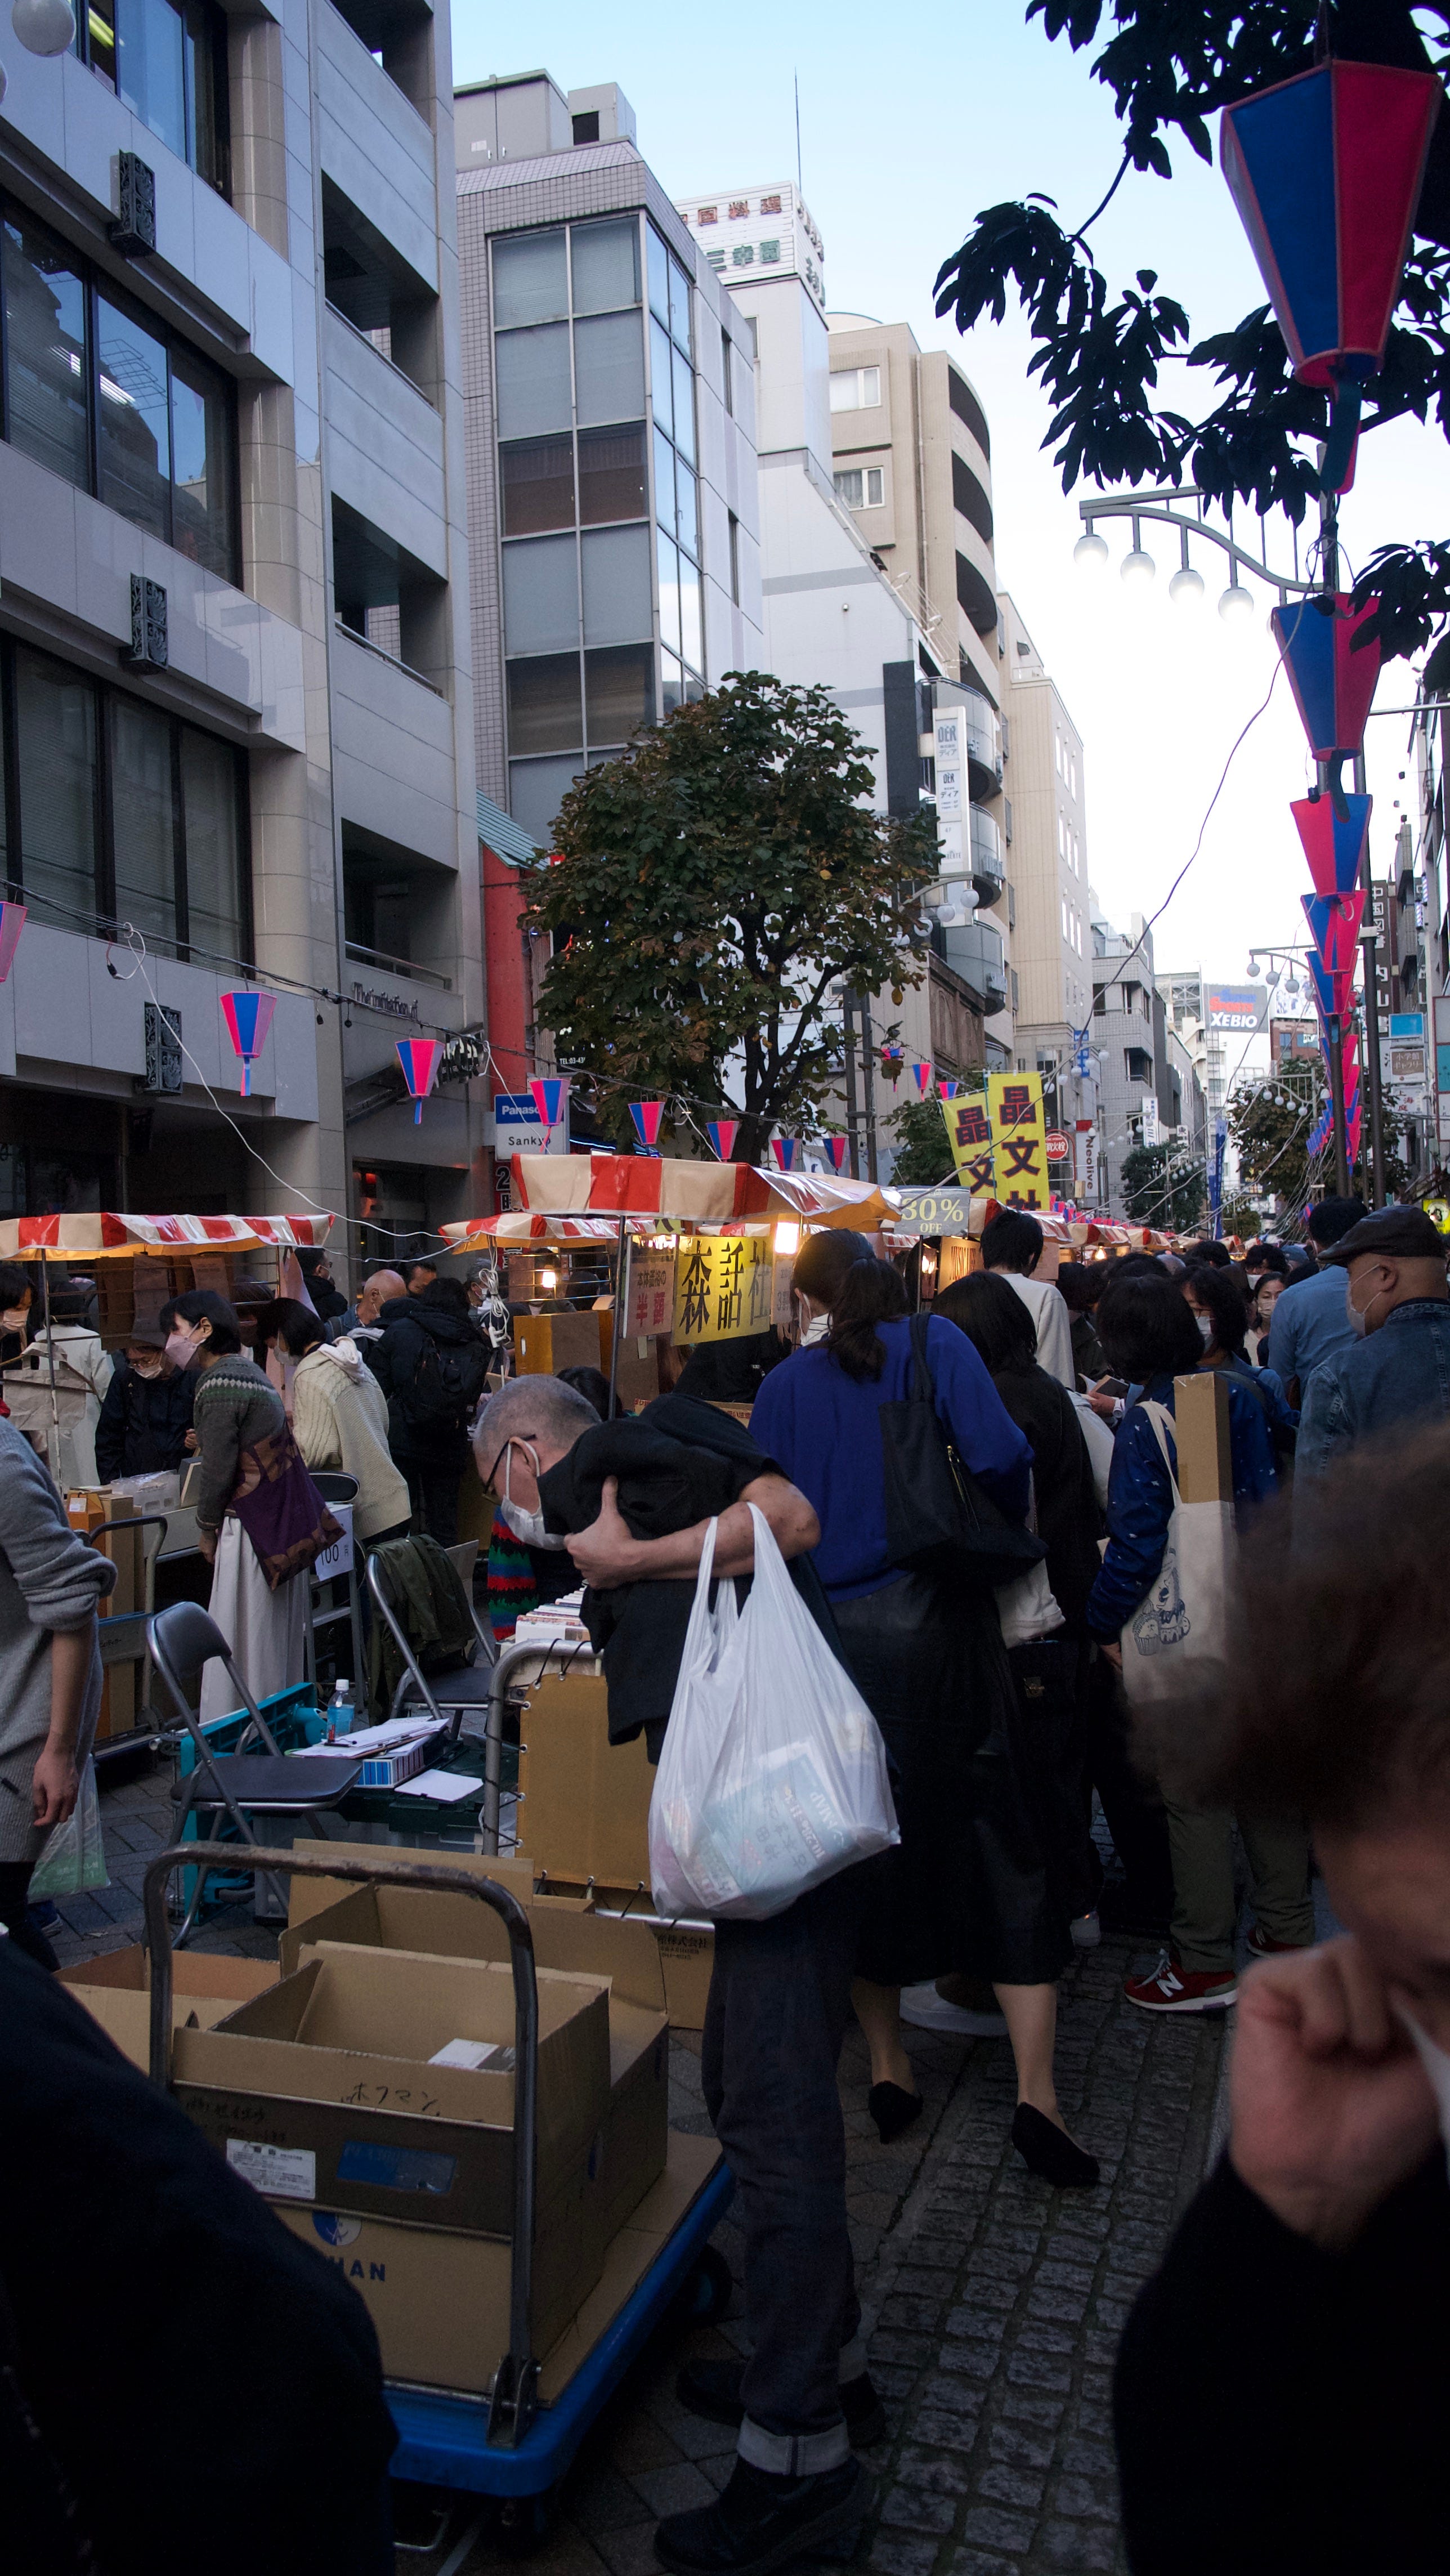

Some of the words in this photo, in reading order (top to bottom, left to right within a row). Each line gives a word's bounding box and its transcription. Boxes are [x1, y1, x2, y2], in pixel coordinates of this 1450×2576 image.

[1211, 1012, 1257, 1028] XEBIO
[1086, 1138, 1095, 1189] Neolive
[902, 1198, 964, 1222] 30%
[920, 1223, 942, 1233] OFF
